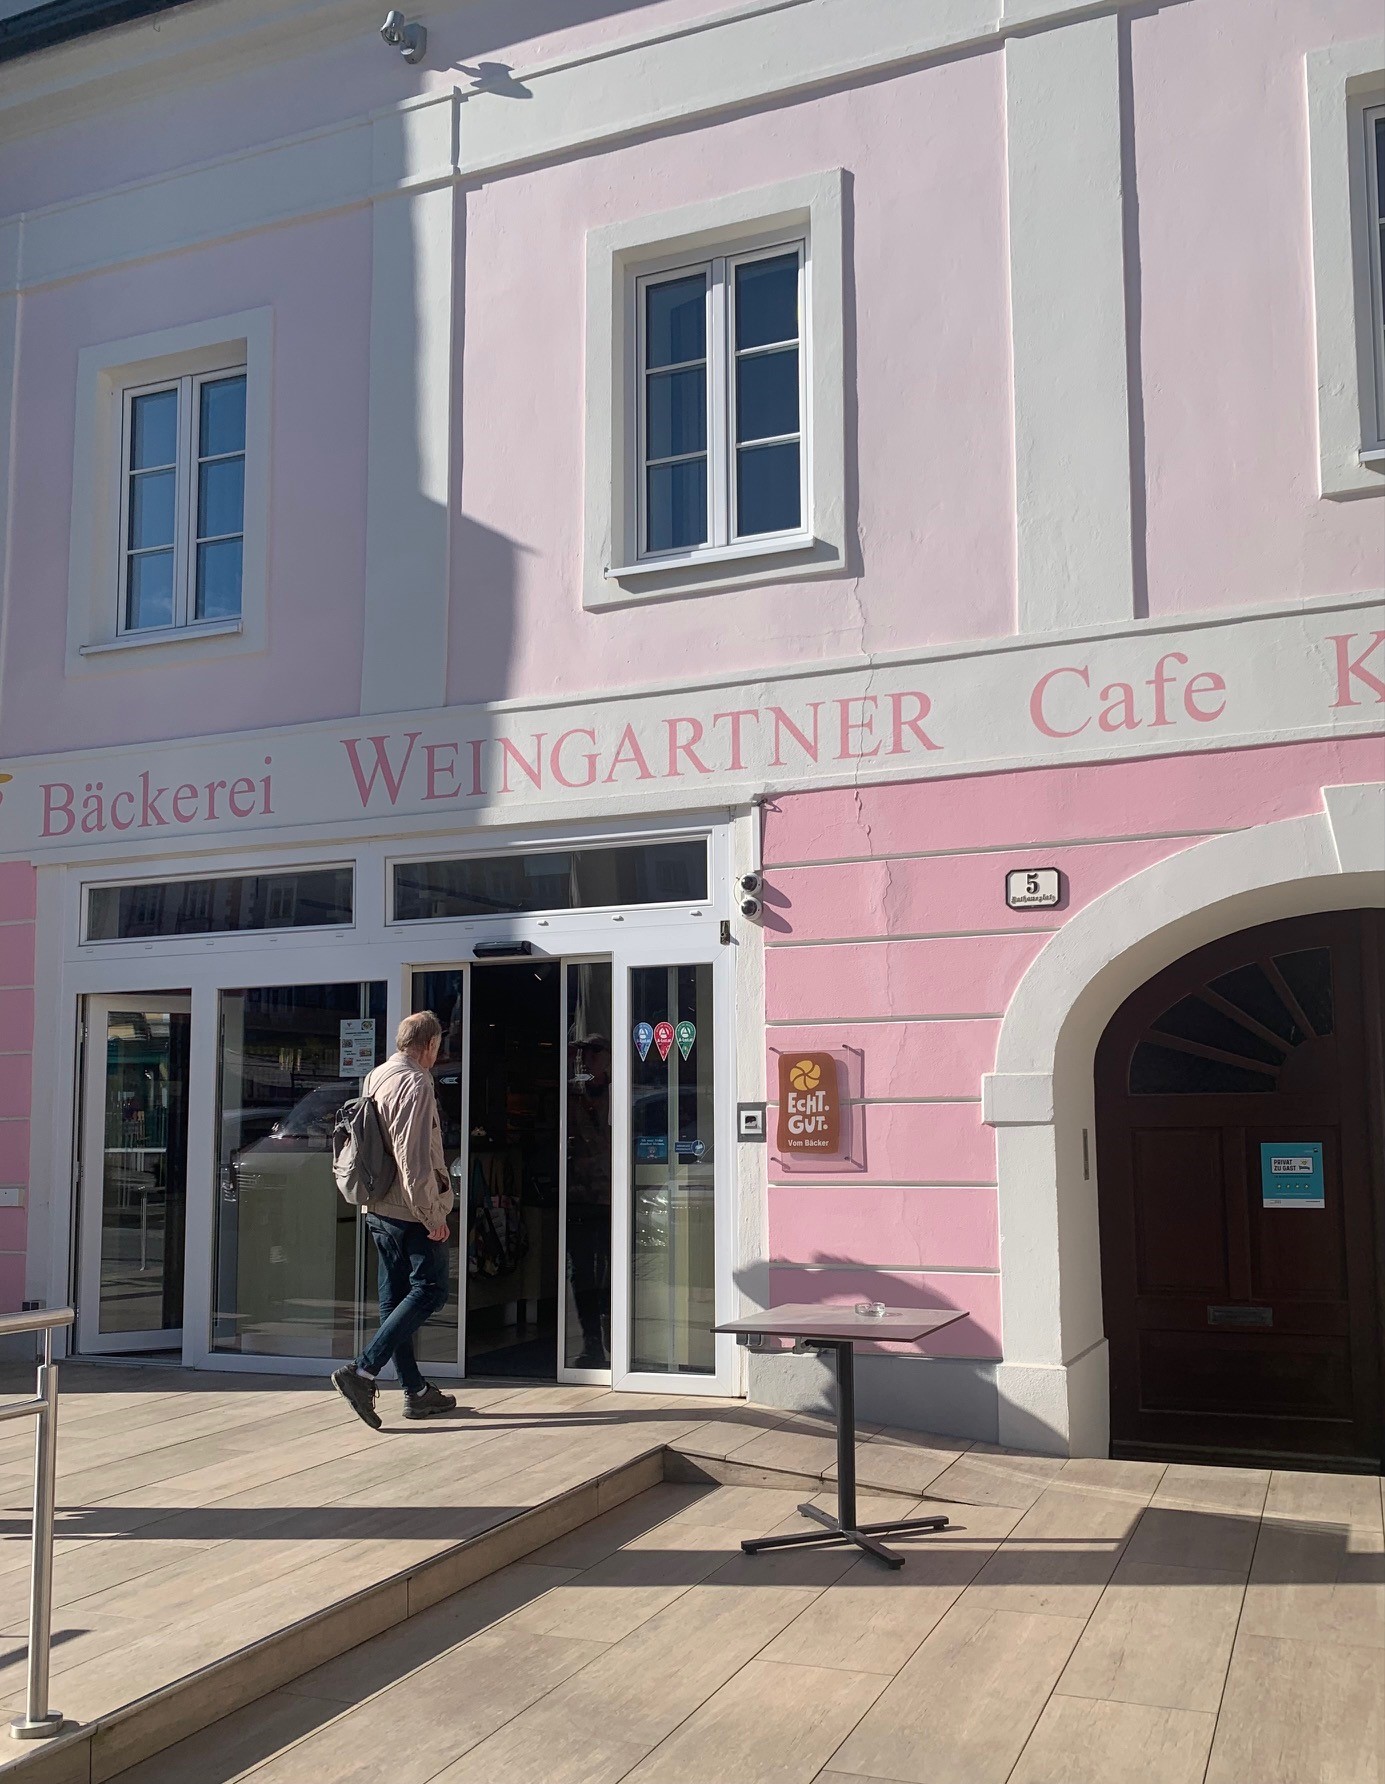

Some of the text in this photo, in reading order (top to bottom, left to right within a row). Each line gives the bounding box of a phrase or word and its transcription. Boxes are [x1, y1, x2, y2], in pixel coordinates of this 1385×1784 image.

[38, 756, 275, 837] Bäckerei
[340, 689, 944, 808] WEINGARTNER
[1029, 652, 1227, 738] Cafe
[1026, 873, 1039, 894] 5
[787, 1115, 829, 1135] GUT.
[788, 1139, 829, 1147] Vom Bäcker
